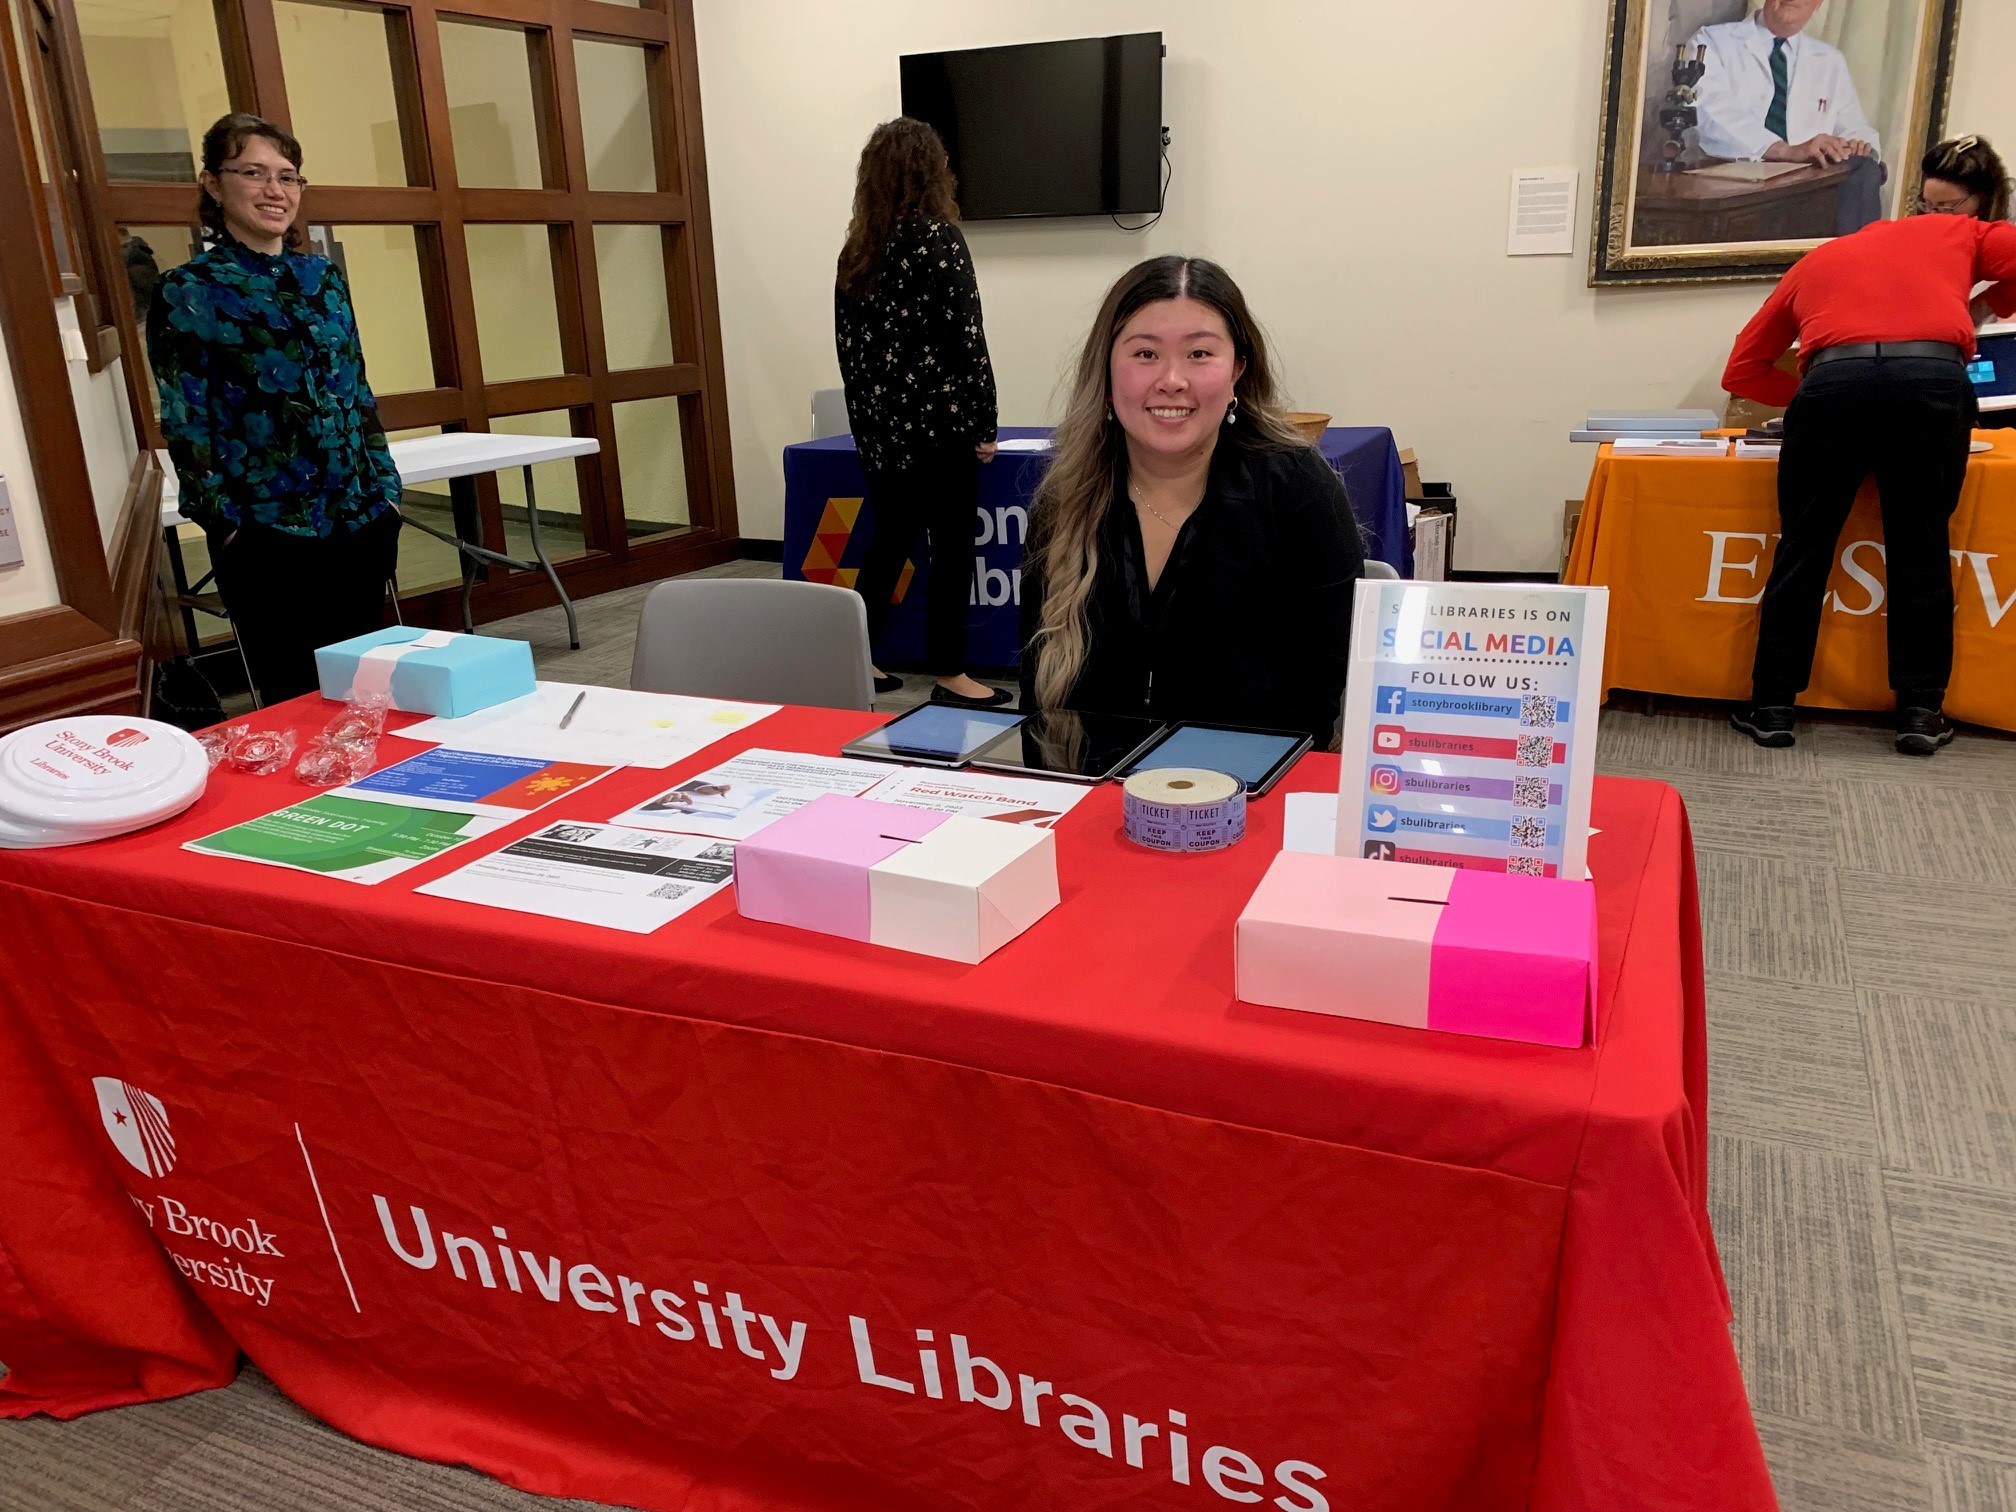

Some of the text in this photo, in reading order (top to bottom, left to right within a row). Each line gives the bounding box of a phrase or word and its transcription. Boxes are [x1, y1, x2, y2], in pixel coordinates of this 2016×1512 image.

[1430, 605, 1516, 619] LIBRARIES
[1523, 609, 1538, 621] IS
[1546, 611, 1571, 622] ON
[1383, 628, 1575, 657] SCIAL MEDIA
[1411, 671, 1539, 691] FOLLOW US:
[1411, 698, 1513, 715] stonybrooklibrary
[56, 730, 135, 771] Stony Brook
[1408, 738, 1474, 751] sbulibraries
[45, 739, 111, 776] University
[30, 757, 70, 780] Libraries
[1405, 778, 1471, 792] sbulibraries
[910, 786, 941, 795] Red
[944, 790, 993, 801] Watch
[996, 796, 1038, 807] Band
[1142, 805, 1170, 819] TICKET
[1190, 807, 1219, 820] TICKET
[272, 810, 331, 825] GREEN
[328, 820, 371, 832] DOT
[1401, 816, 1466, 830] sbulibraries
[1148, 827, 1167, 835] KEEP
[1142, 836, 1171, 846] COUPON
[1189, 839, 1220, 847] COUPON
[1400, 855, 1464, 869] sbulibraries
[157, 1195, 285, 1258] Brook
[164, 1247, 275, 1306] ersity
[372, 1194, 1330, 1512] University Libraries
